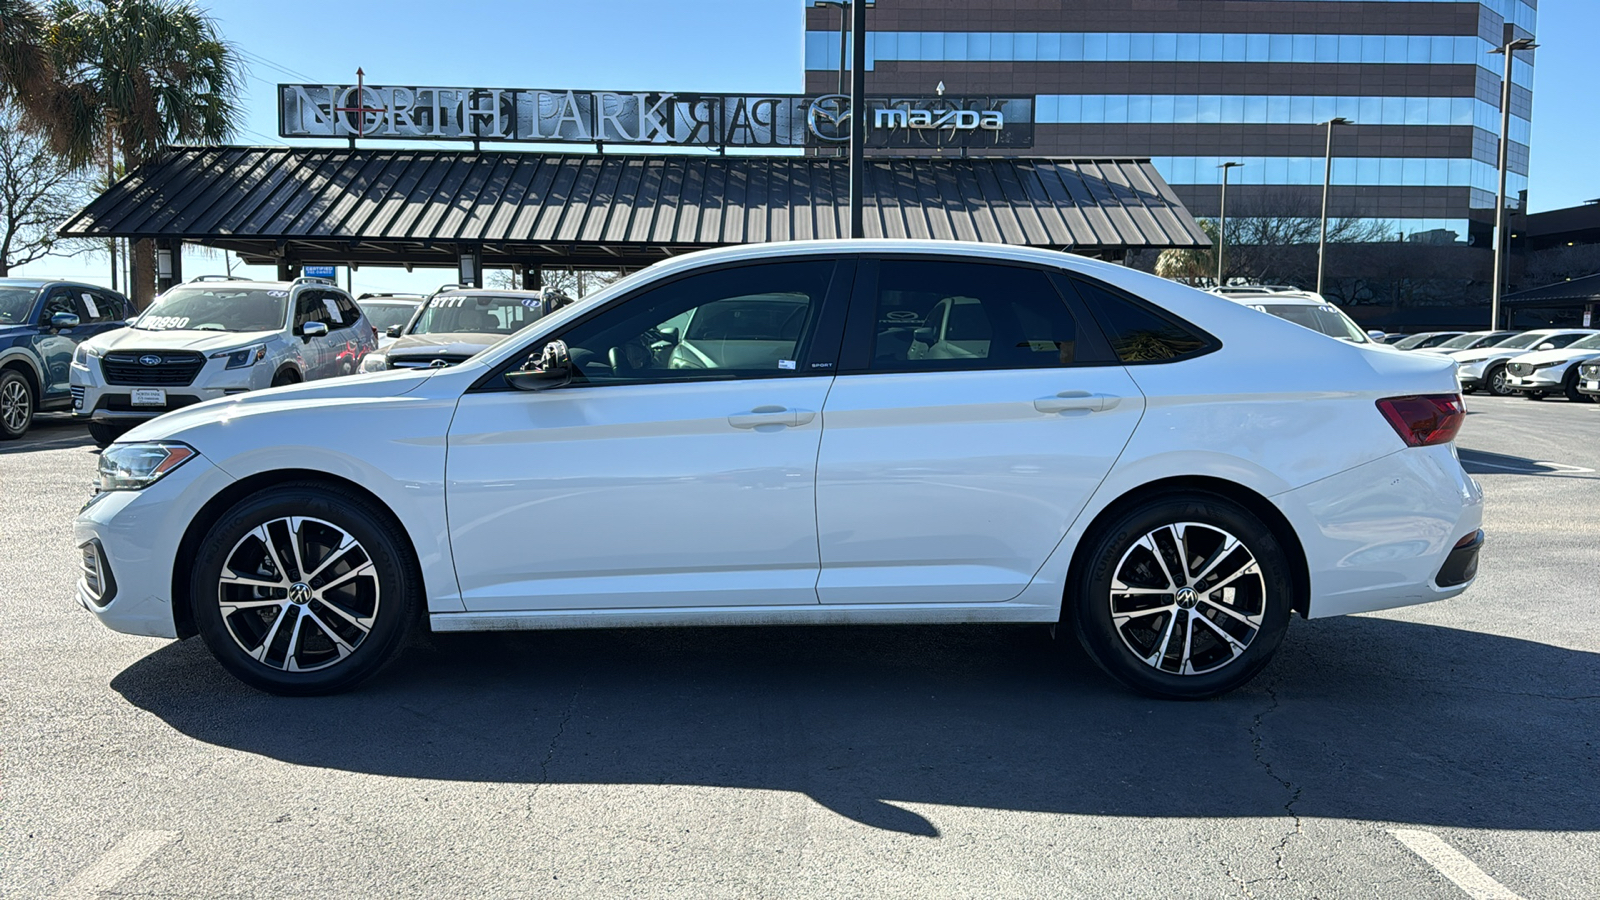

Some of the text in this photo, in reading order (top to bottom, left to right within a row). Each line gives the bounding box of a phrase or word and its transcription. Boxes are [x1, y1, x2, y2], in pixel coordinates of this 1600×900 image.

[289, 84, 506, 138] NORTH
[526, 90, 678, 143] PARK
[874, 108, 1004, 130] mazda
[429, 296, 467, 308] 9777
[1094, 530, 1129, 582] KUMHO
